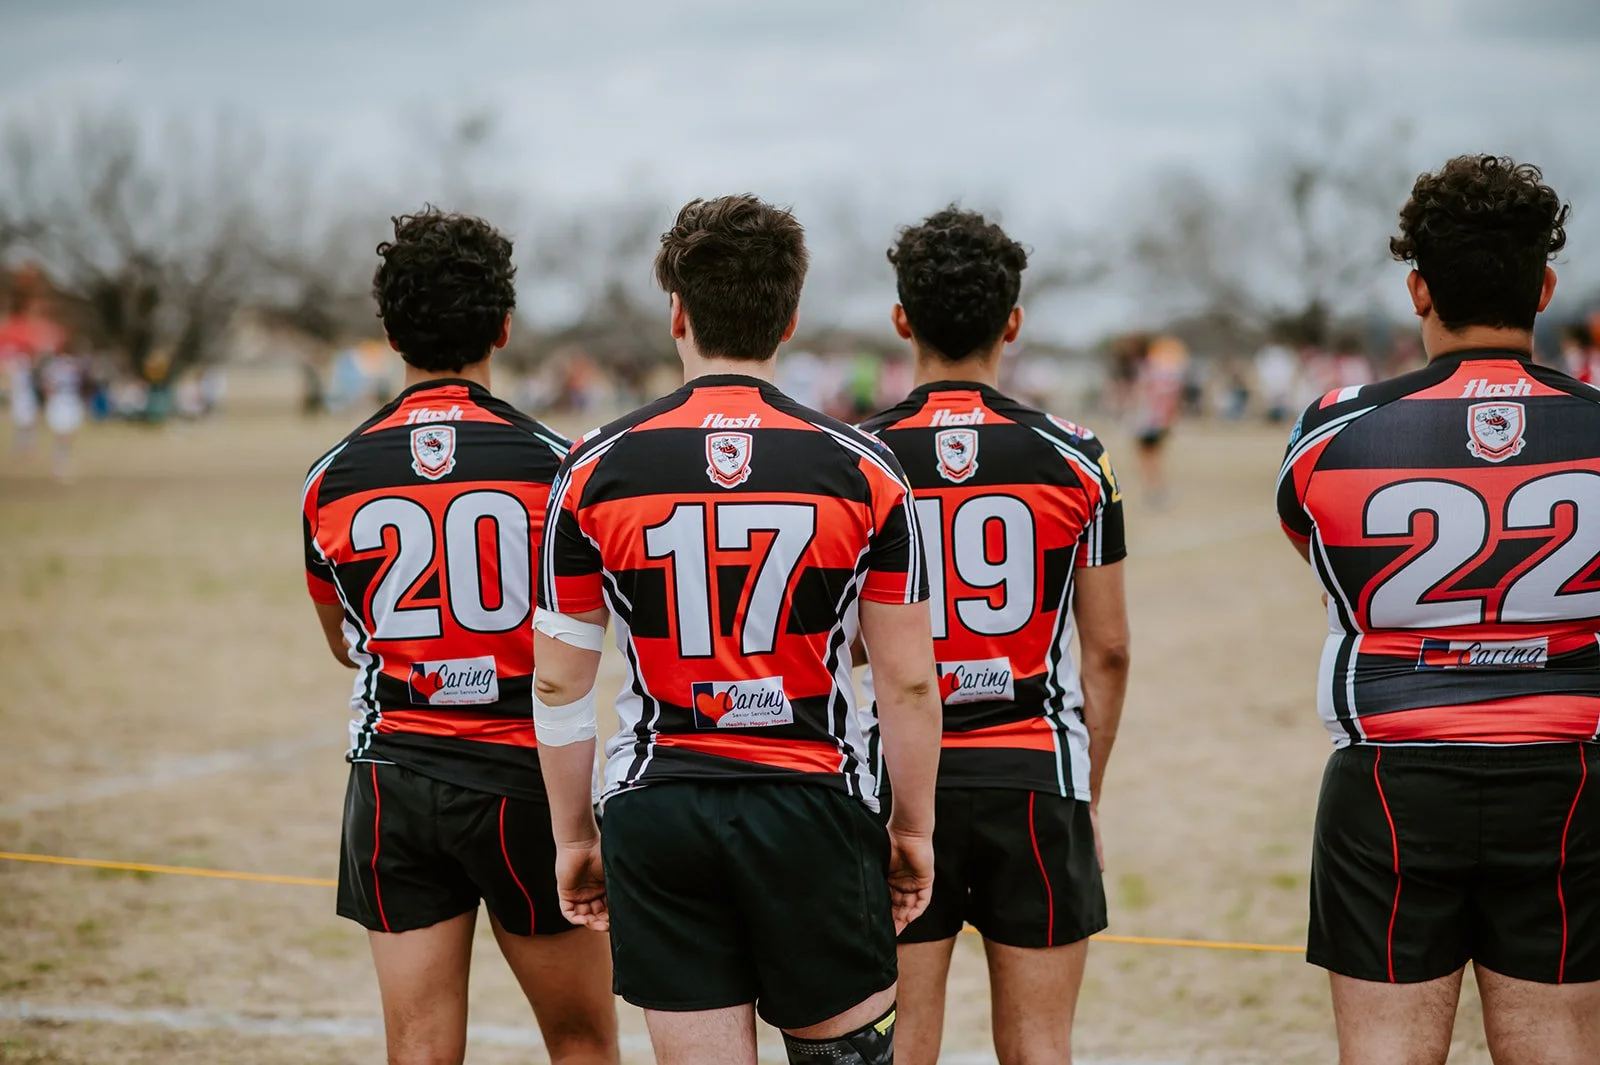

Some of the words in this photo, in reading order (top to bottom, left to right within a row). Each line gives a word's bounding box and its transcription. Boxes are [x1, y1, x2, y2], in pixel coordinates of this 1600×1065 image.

[1459, 378, 1532, 398] flash
[405, 406, 464, 425] flash
[700, 413, 761, 428] flash
[929, 407, 985, 427] flash
[1361, 469, 1600, 631] 22
[350, 489, 531, 641] 20
[643, 501, 817, 659] 17
[434, 664, 495, 694] Caring
[951, 665, 1010, 694] Caring
[724, 685, 784, 715] Caring
